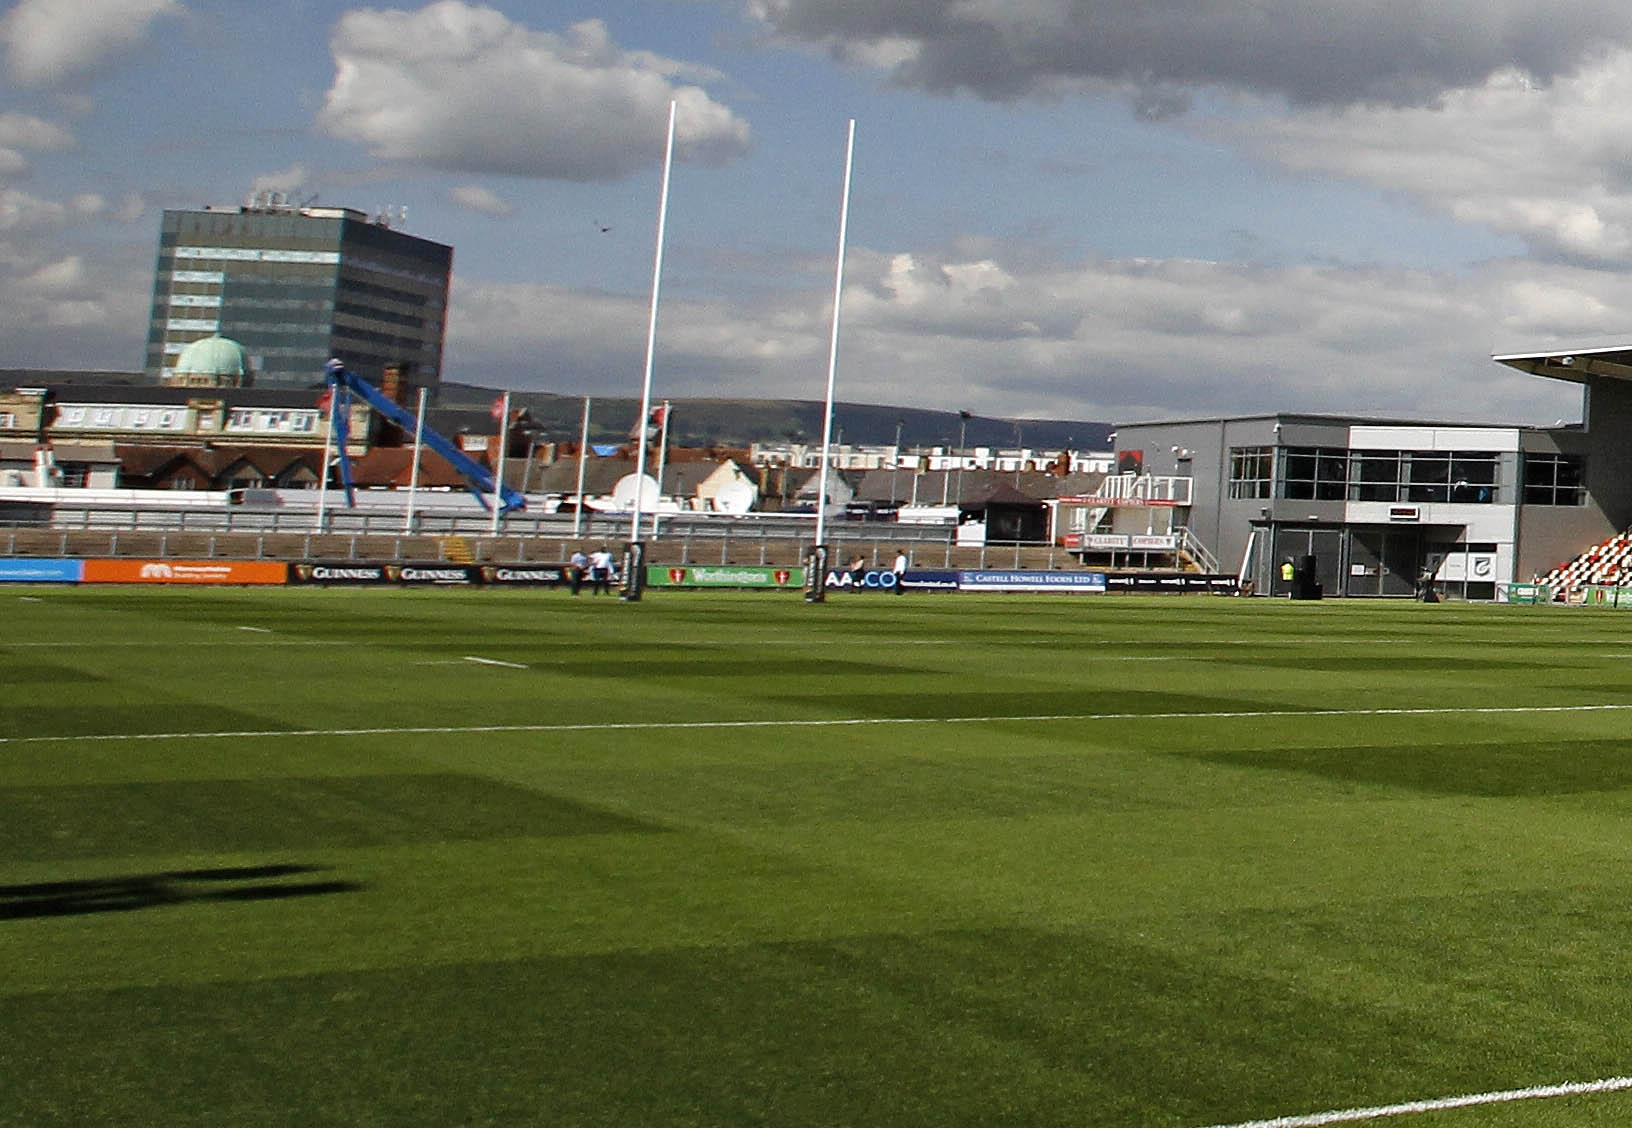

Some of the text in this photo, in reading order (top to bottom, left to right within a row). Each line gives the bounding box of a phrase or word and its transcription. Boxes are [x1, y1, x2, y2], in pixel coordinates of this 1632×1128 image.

[312, 567, 381, 579] GUINNESS
[401, 568, 468, 580] GUINNESS
[496, 569, 560, 581] GUINNESS
[976, 575, 1009, 583] CASTELL
[1010, 575, 1043, 583] HOWELL
